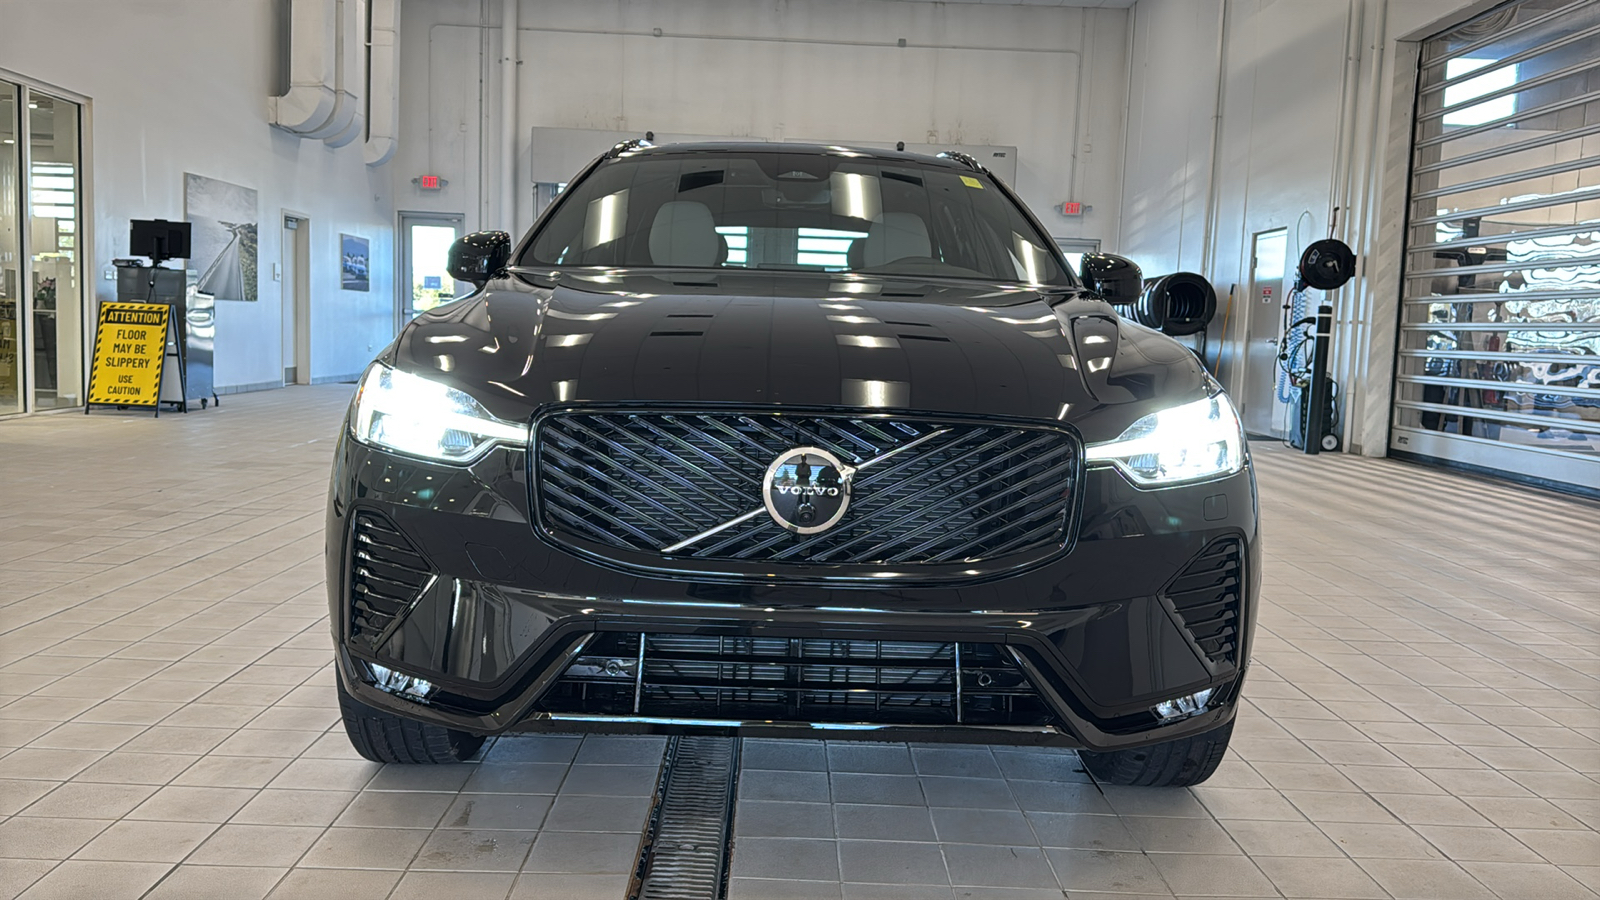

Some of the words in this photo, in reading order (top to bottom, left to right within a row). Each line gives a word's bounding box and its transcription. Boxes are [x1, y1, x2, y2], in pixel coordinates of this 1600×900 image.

[422, 176, 438, 188] EXIT
[1066, 202, 1080, 214] EXIT
[107, 311, 160, 324] ATTENTION
[116, 329, 147, 340] FLOOR
[112, 343, 132, 354] MAY
[134, 344, 147, 354] BE
[106, 356, 150, 368] SLIPPERY
[118, 374, 133, 384] USE
[108, 386, 141, 396] CAUTION
[776, 484, 838, 496] VOLVO
